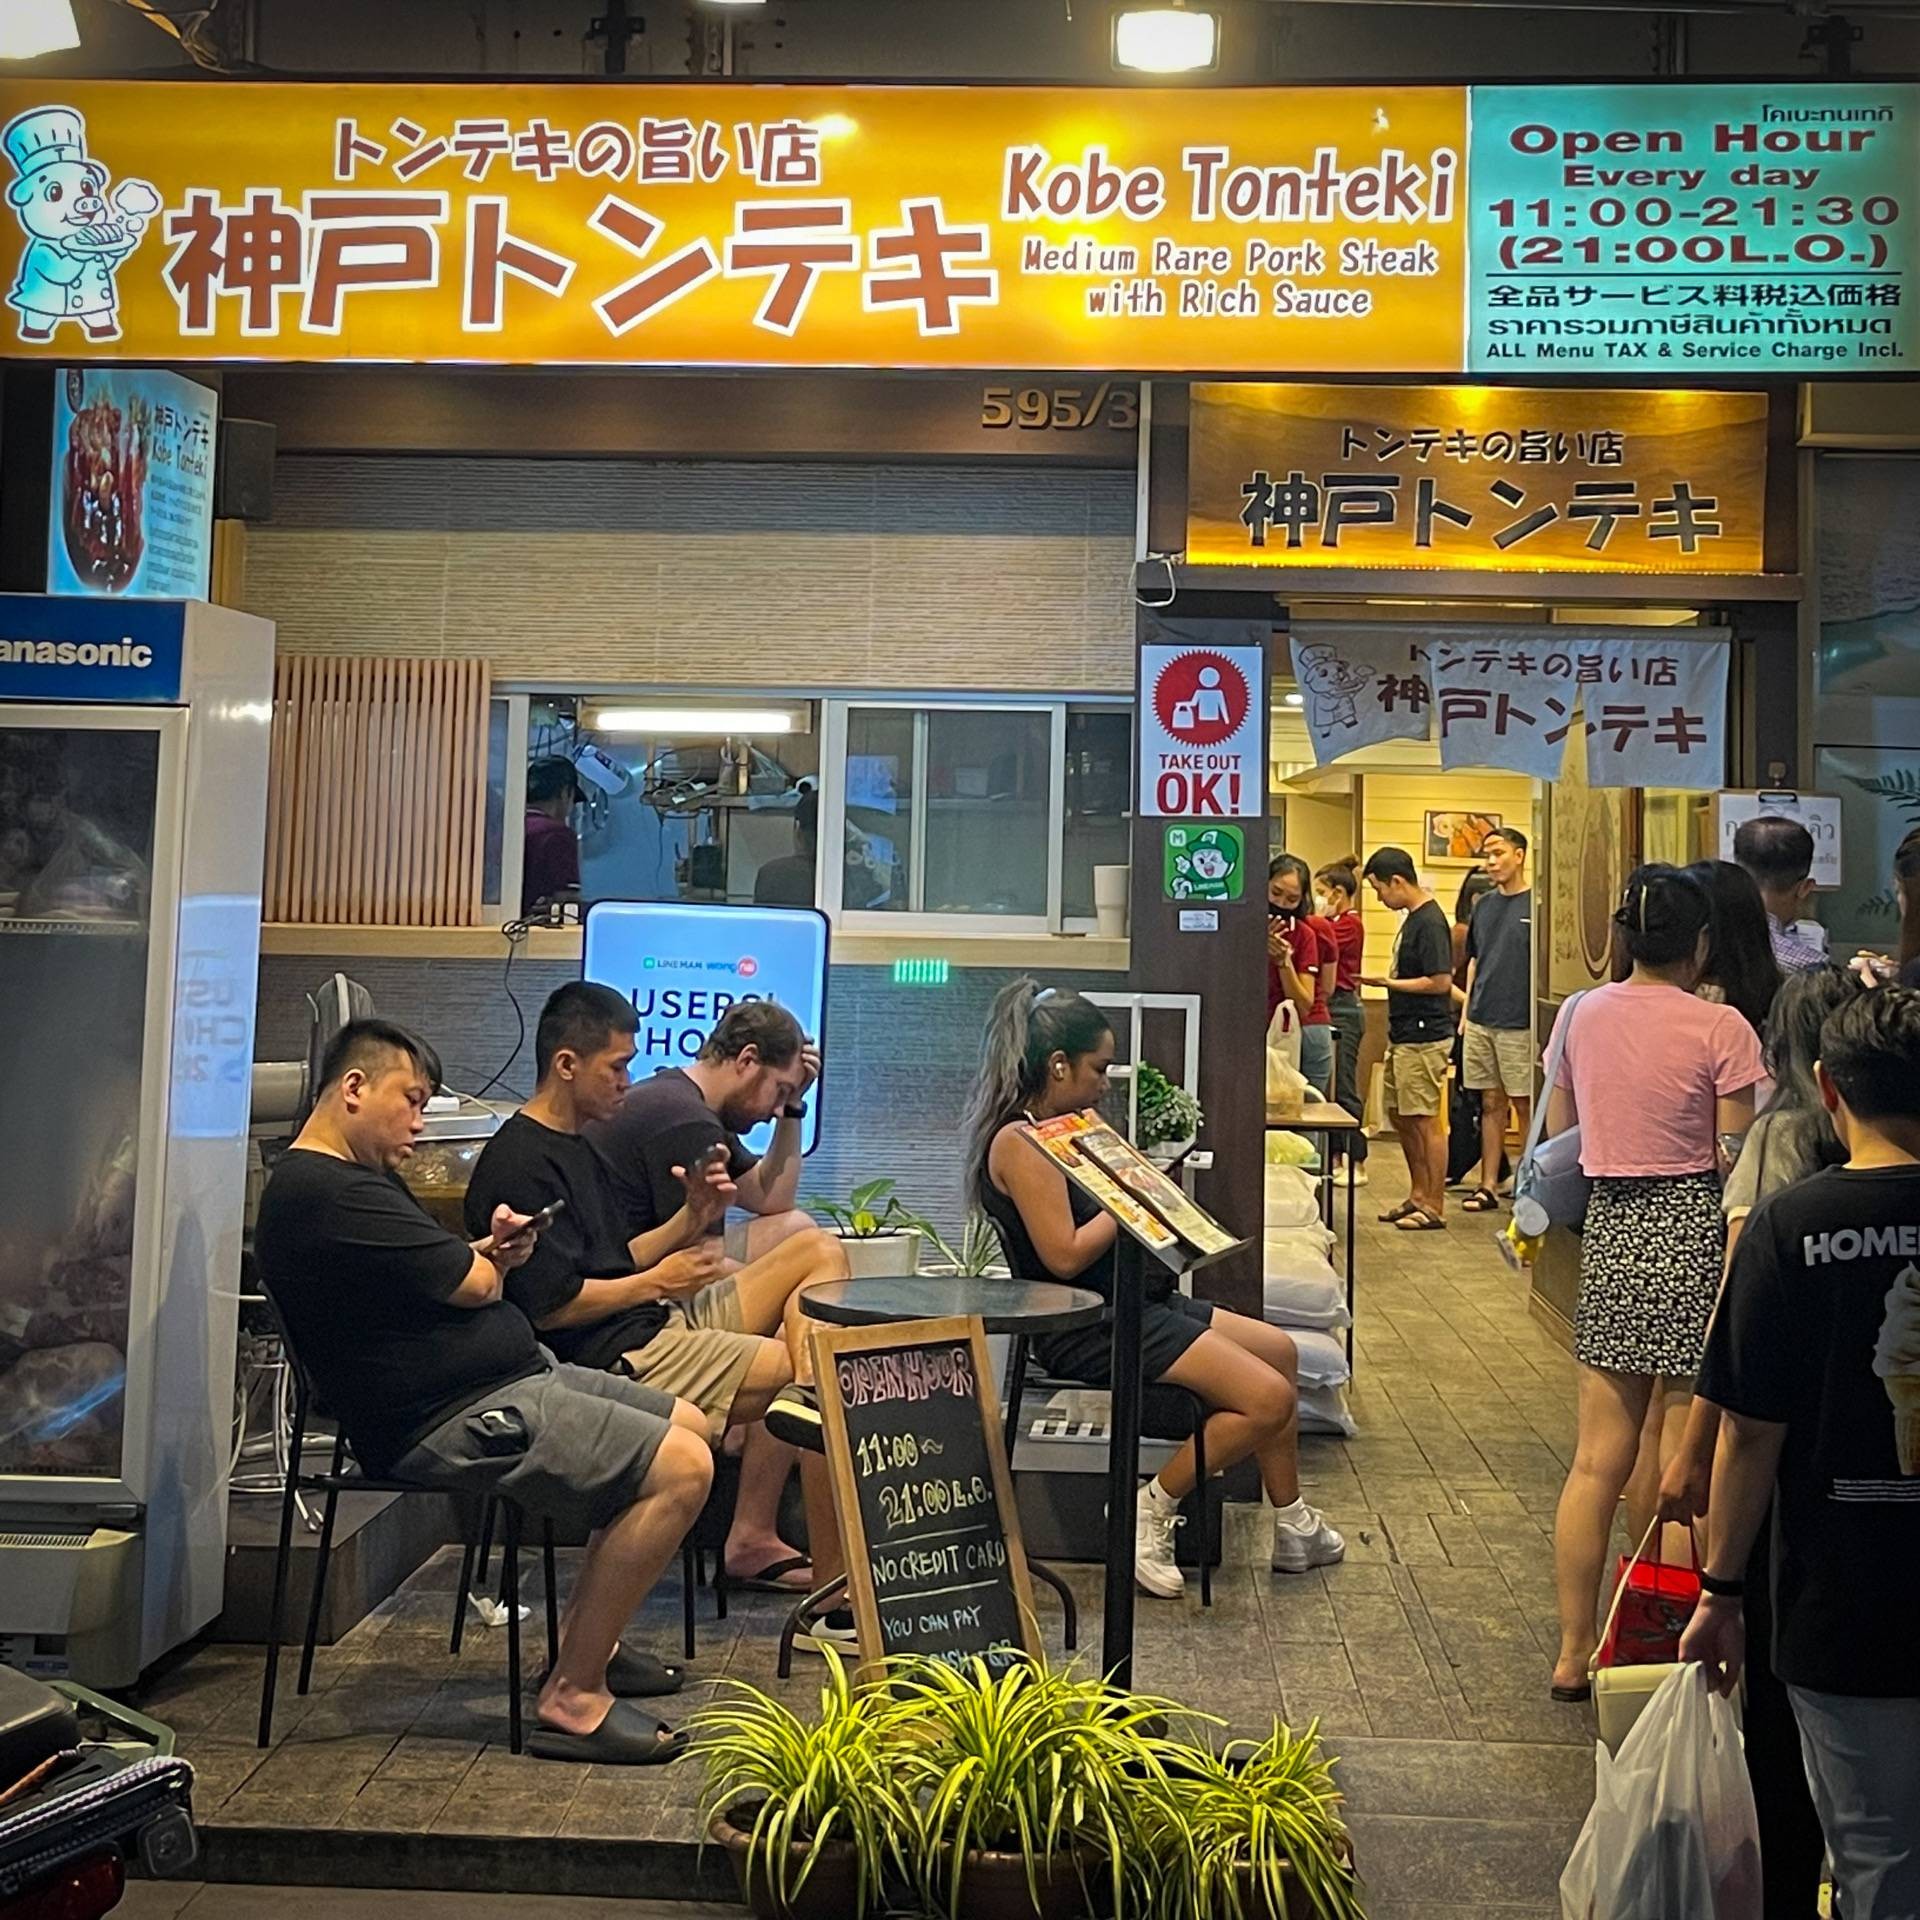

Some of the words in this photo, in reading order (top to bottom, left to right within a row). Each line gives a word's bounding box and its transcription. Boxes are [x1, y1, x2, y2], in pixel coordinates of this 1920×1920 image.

[336, 118, 819, 184] トンテキの旨い店
[1509, 124, 1683, 159] Open
[1714, 124, 1875, 153] Hour
[1004, 150, 1161, 216] Kobe
[1187, 150, 1454, 218] Tonteki
[1564, 165, 1706, 190] Every
[1730, 164, 1820, 190] day
[1489, 197, 1899, 227] 11:00-21:30
[165, 194, 995, 334] 神戸トンテキ
[1024, 240, 1135, 272] Medium
[1156, 242, 1228, 272] Rare
[1249, 241, 1322, 272] Pork
[1343, 241, 1437, 273] Steak
[1089, 283, 1163, 314] with
[1183, 284, 1257, 314] Rich
[1275, 284, 1370, 314] Sauce
[1488, 284, 1901, 307] 全品サービス料税込価格
[1487, 343, 1526, 358] ALL
[1537, 343, 1594, 358] Menu
[1604, 343, 1648, 358] TAX
[1658, 343, 1672, 358] &
[1683, 343, 1761, 358] Service
[1772, 343, 1848, 361] Charge
[1859, 343, 1904, 358] Incl.
[982, 382, 1138, 429] 595/3
[1339, 427, 1625, 465] トンテキの旨い店
[1240, 471, 1722, 553] 神戸トンテキ
[1409, 644, 1679, 686] トンテキの旨い店
[1377, 673, 1707, 754] 神戸トンテキ
[1158, 754, 1203, 770] TAKE
[1207, 755, 1241, 770] OUT
[1156, 772, 1241, 815] OK!
[1803, 1226, 1920, 1267] HOME
[838, 1354, 905, 1408] OPEN
[902, 1347, 973, 1401] HOUR
[872, 1555, 898, 1587] NO
[900, 1545, 959, 1580] CREDIT
[965, 1541, 1006, 1570] CARD
[882, 1616, 913, 1641] YOU
[919, 1613, 949, 1634] CAN
[953, 1604, 982, 1629] PAY
